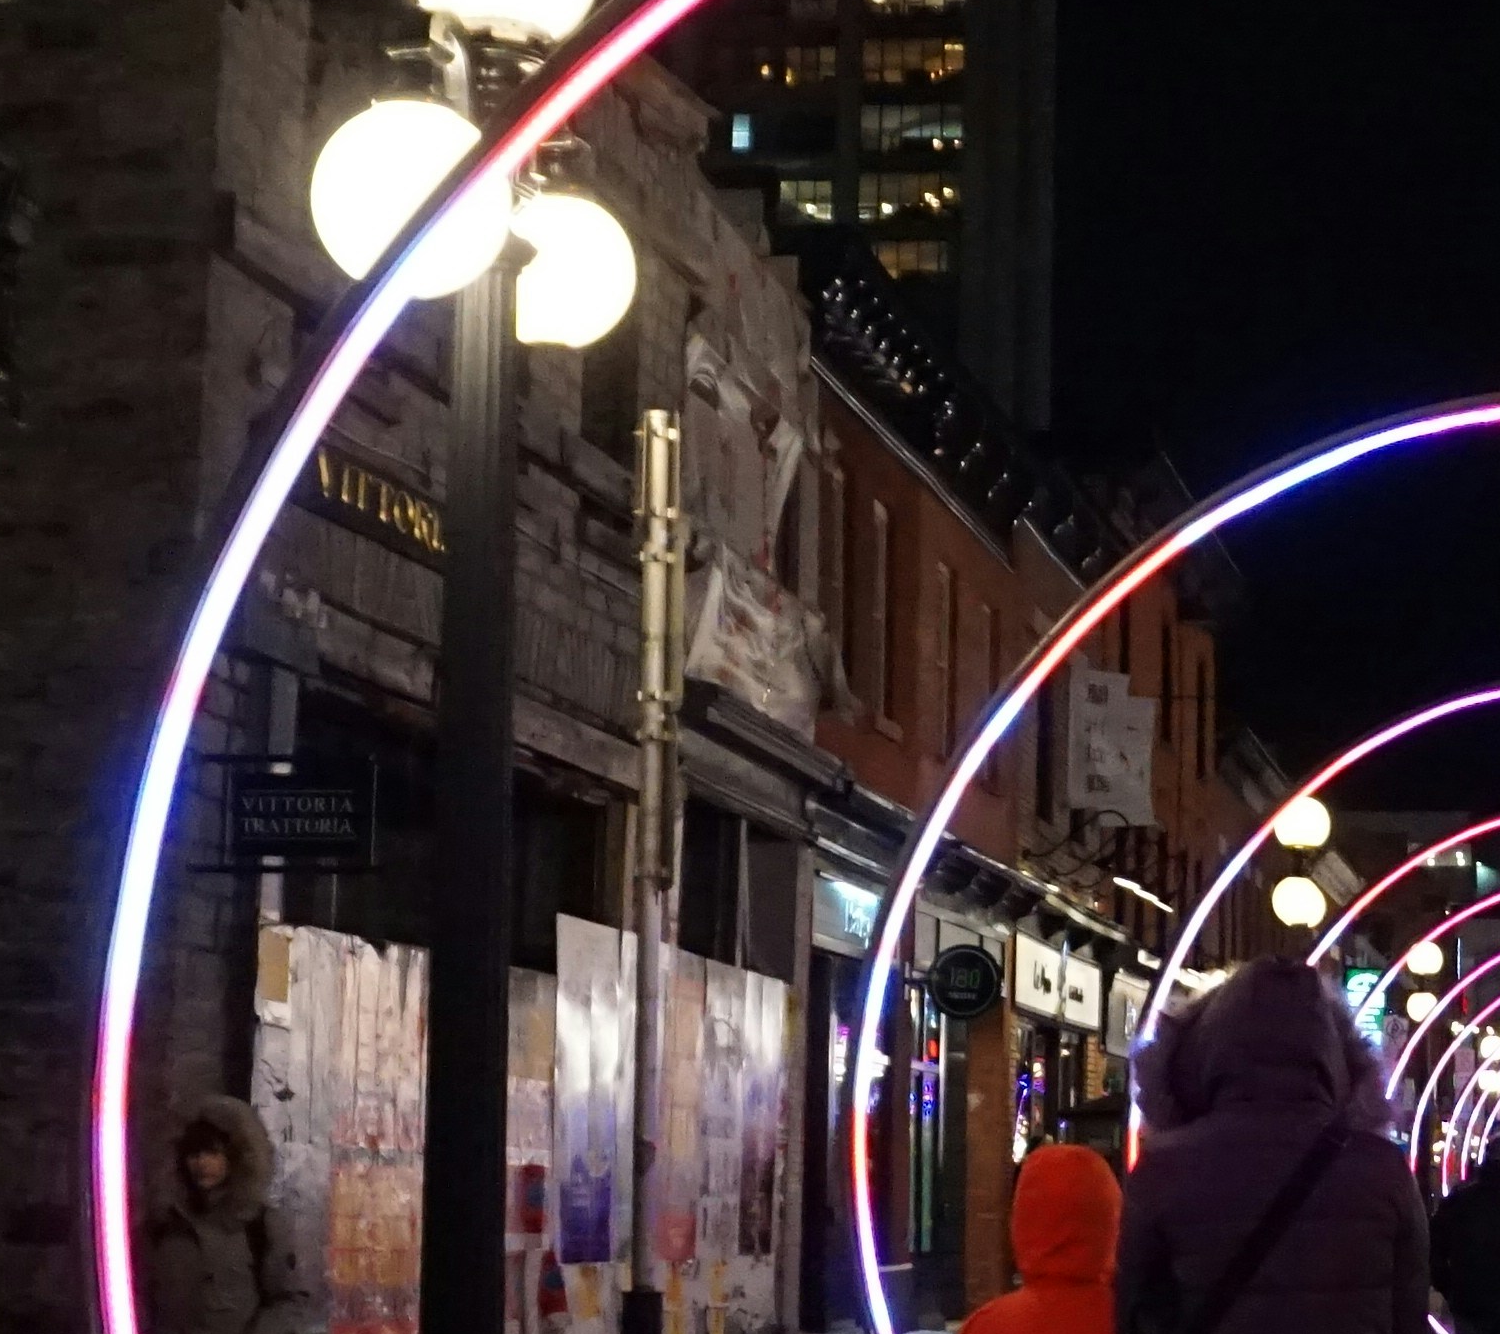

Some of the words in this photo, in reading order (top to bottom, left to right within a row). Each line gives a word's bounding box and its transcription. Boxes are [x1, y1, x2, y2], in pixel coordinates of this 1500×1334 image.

[316, 448, 446, 553] VITTORI
[241, 795, 354, 813] VITTORIA
[240, 816, 356, 834] TRATTORIA
